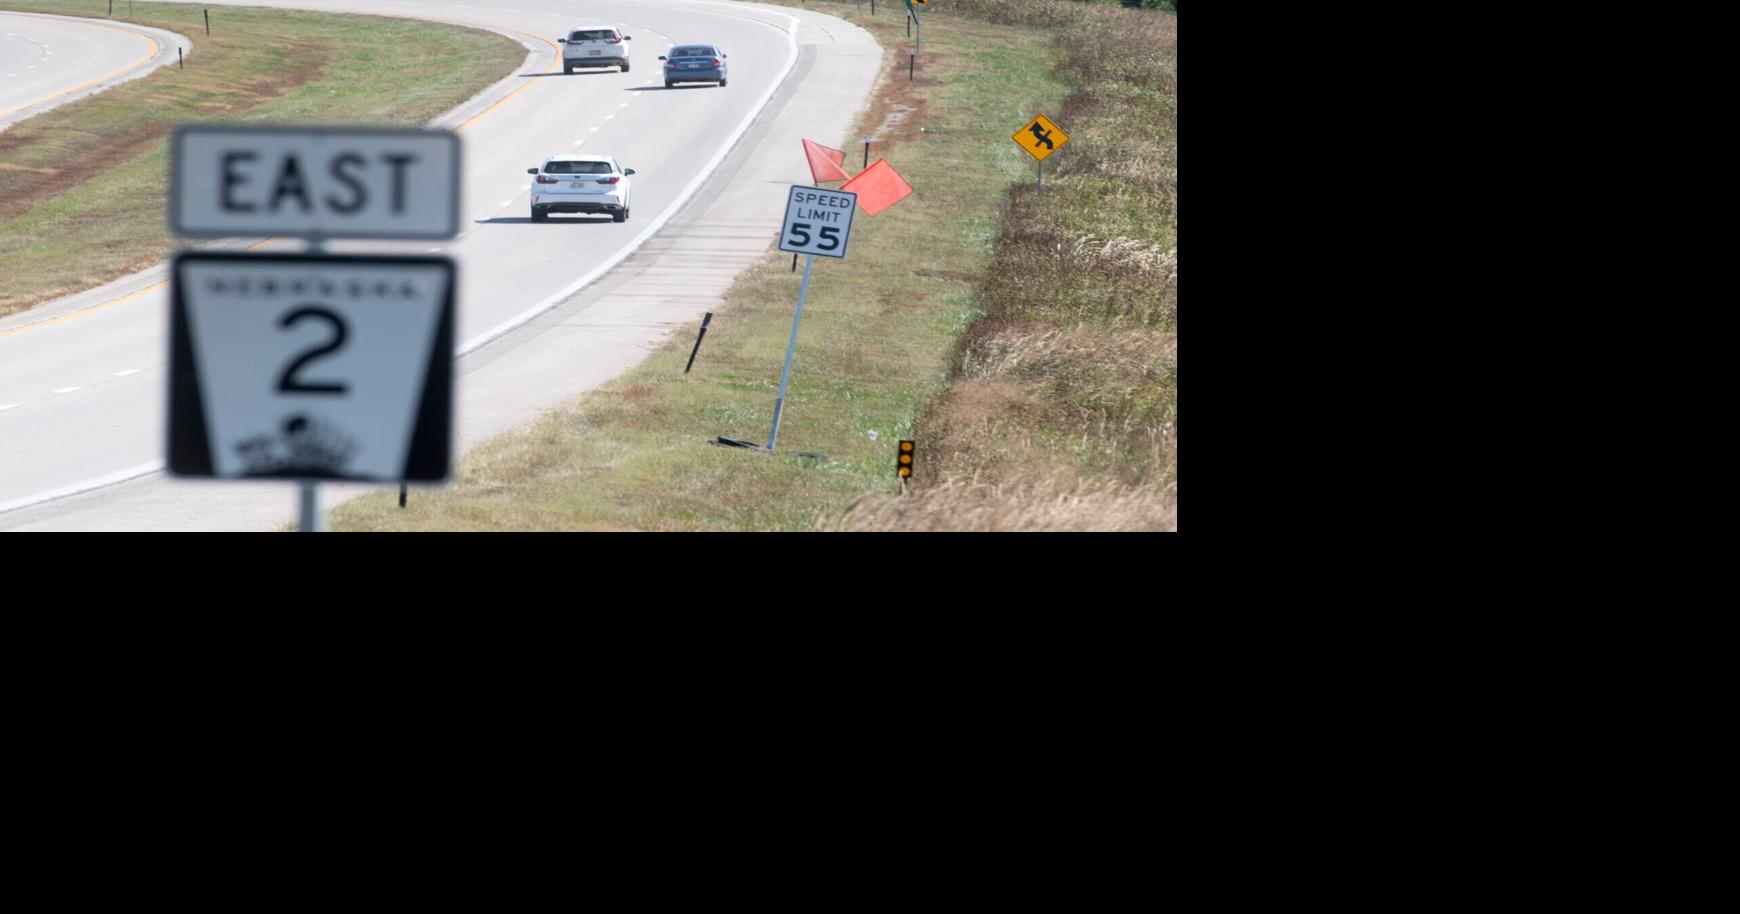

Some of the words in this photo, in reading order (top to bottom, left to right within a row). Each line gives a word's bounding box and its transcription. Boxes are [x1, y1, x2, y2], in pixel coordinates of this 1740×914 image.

[218, 151, 419, 215] EAST
[795, 192, 850, 209] SPEED
[797, 207, 841, 222] LIMIT
[787, 222, 840, 251] 55
[275, 305, 350, 395] 2
